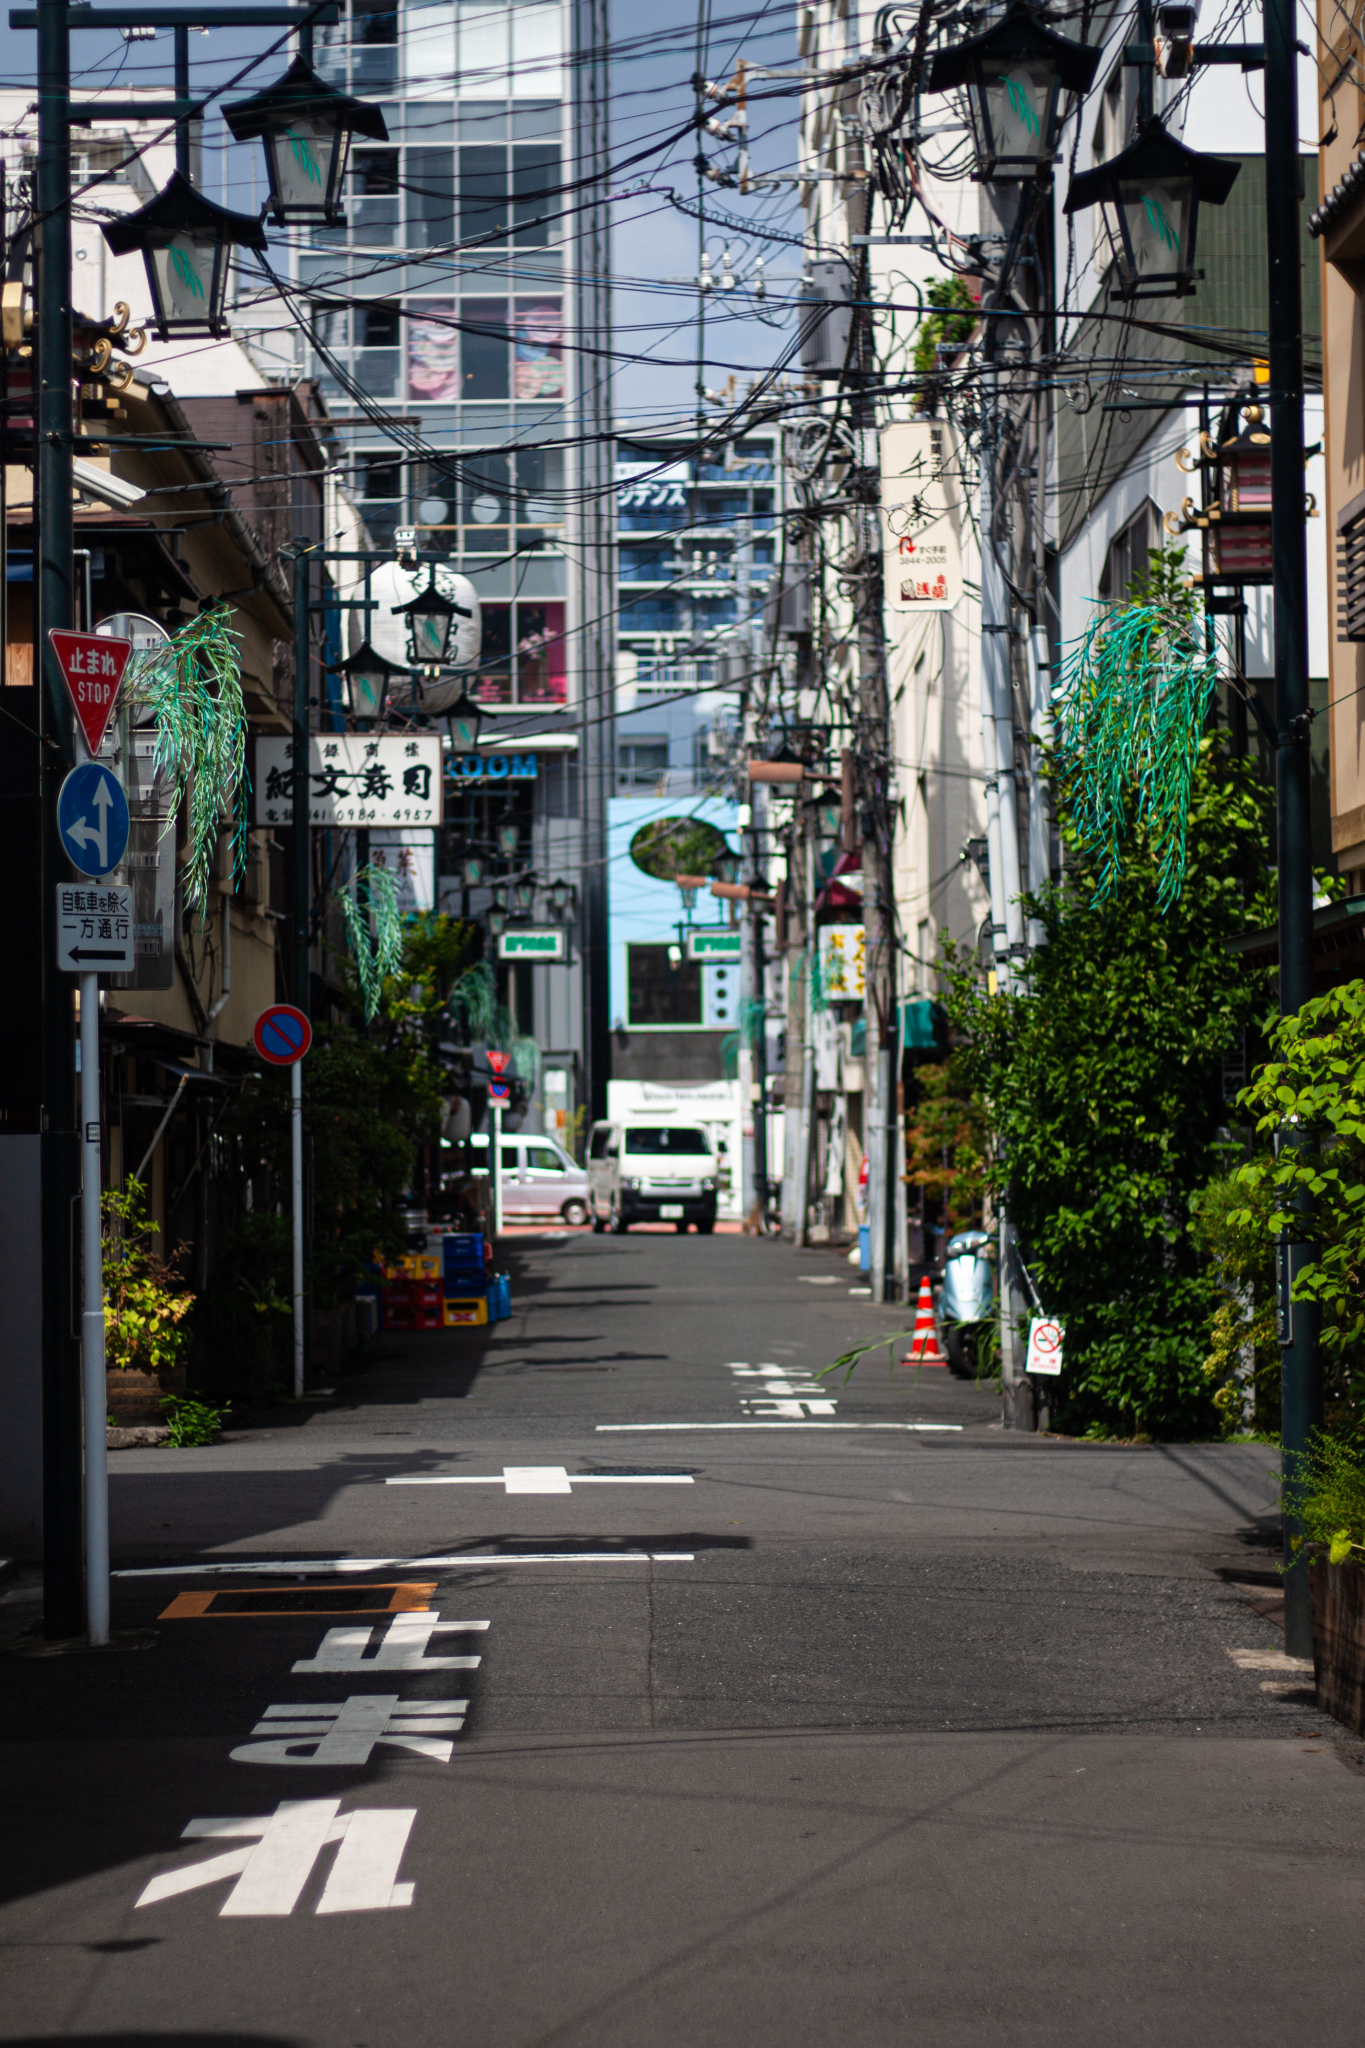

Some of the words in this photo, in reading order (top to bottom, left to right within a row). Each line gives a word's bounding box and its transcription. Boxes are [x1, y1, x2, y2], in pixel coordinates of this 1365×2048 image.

[899, 555, 948, 565] 3844-2005
[69, 647, 117, 676] 止まれ
[78, 681, 110, 705] STOP
[62, 890, 129, 913] 自転車を除く
[62, 917, 130, 940] 一方通行
[134, 1611, 491, 1917] 止まれ
